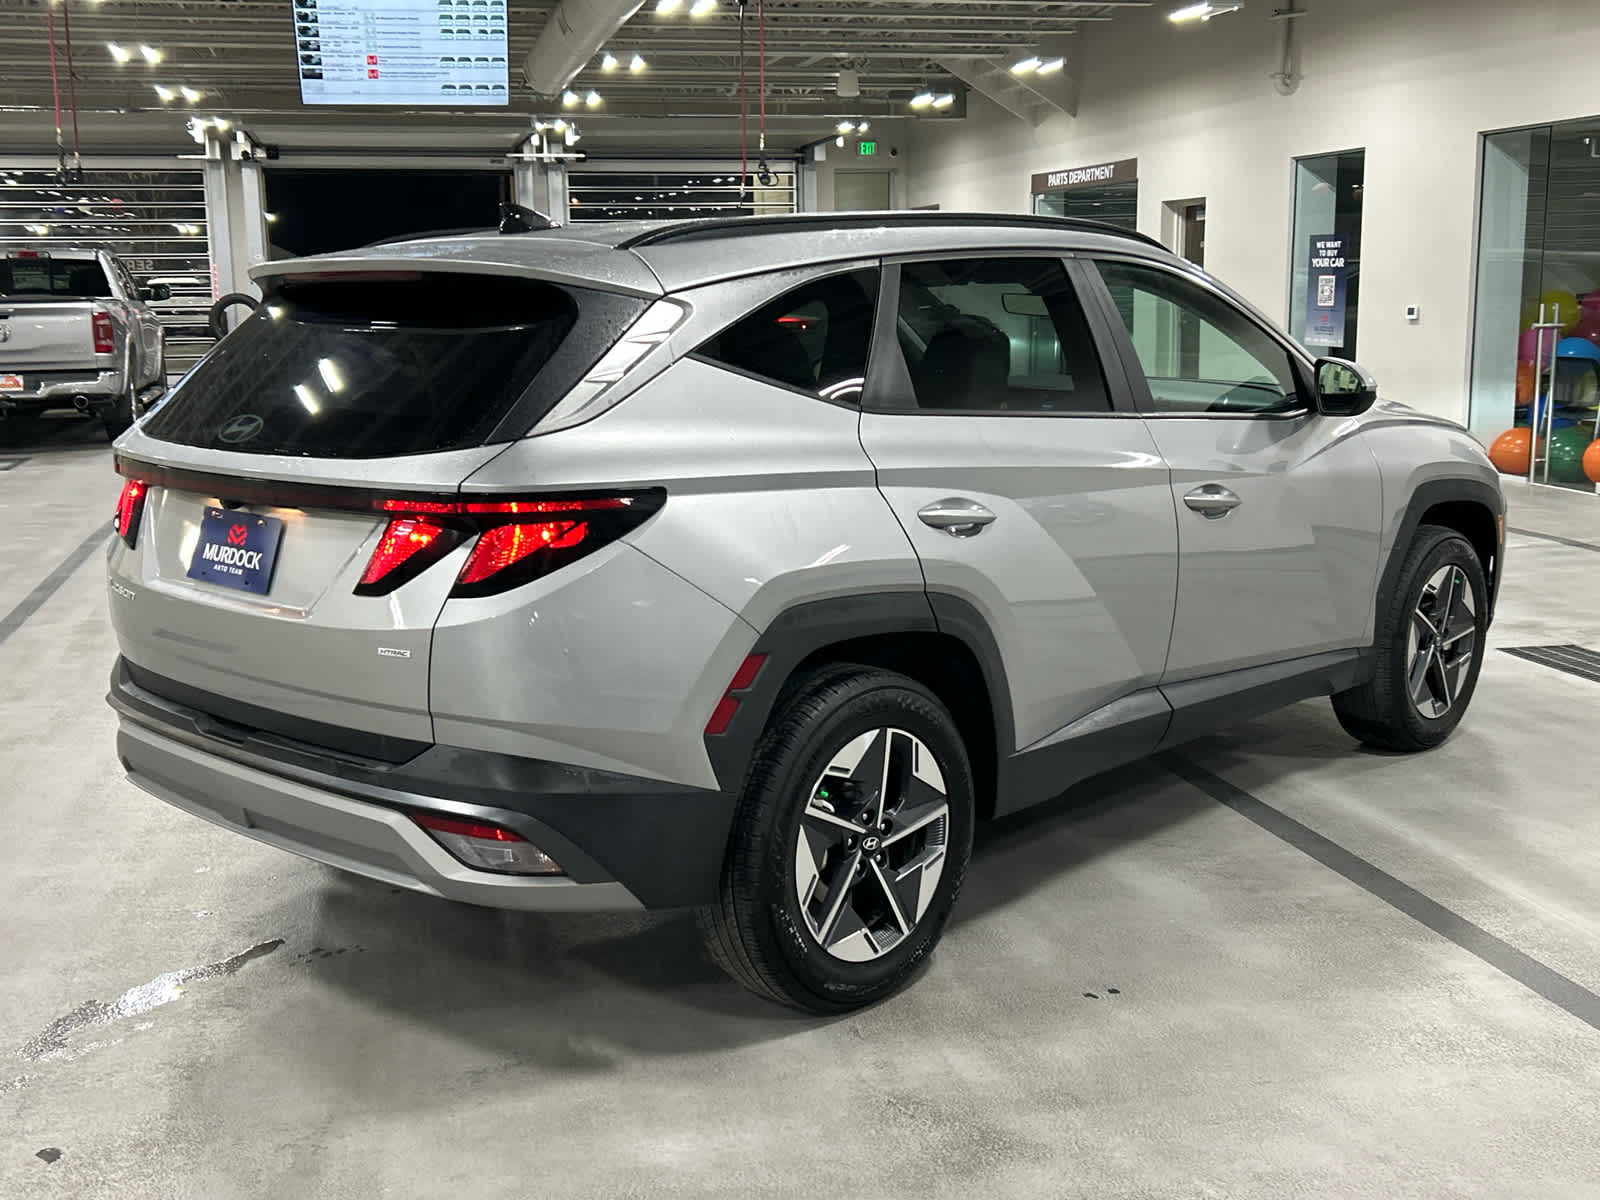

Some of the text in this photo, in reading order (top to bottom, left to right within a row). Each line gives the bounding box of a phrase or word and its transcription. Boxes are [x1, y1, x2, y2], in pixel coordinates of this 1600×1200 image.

[861, 142, 876, 155] EXIT
[1047, 164, 1115, 187] PARTS DEPARTMENT
[1316, 240, 1342, 249] WE WANT
[1319, 249, 1338, 257] TO BUY
[1311, 257, 1345, 268] YOUR CAR
[202, 542, 263, 571] MURDOCK
[213, 563, 244, 576] AUTO TEAM
